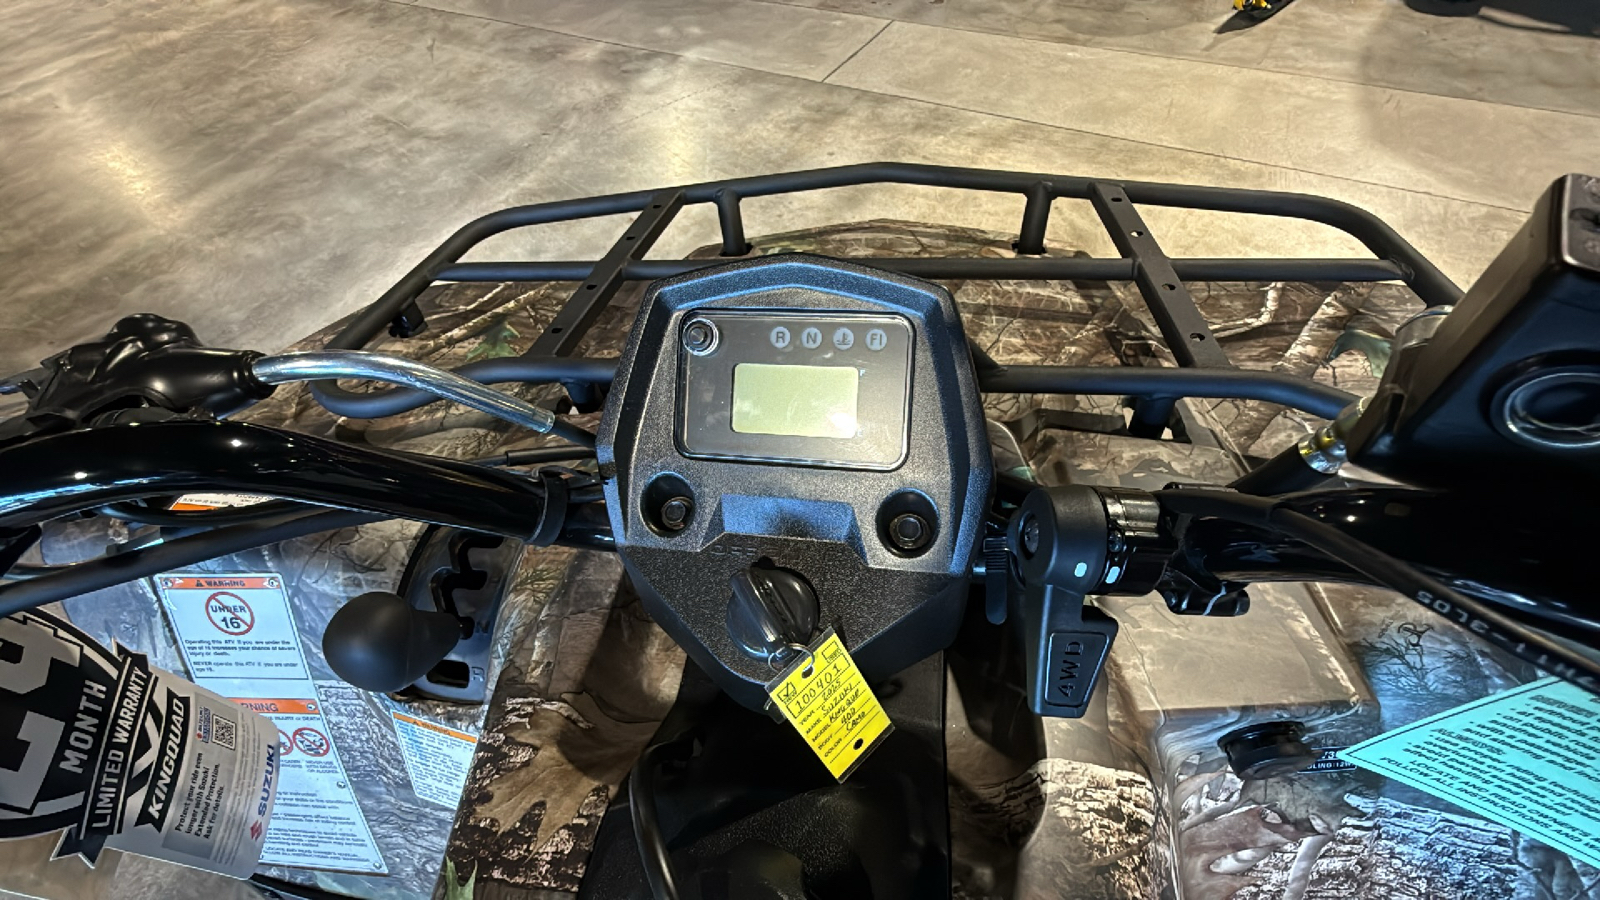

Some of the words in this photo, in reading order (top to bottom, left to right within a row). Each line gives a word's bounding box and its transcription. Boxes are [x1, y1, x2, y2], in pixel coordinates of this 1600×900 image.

[775, 331, 786, 344] R
[806, 332, 817, 344] N
[870, 333, 883, 345] FI
[210, 605, 247, 613] UNDER
[221, 617, 241, 629] 16
[1058, 641, 1084, 697] 4WD
[795, 663, 842, 714] 100401
[59, 679, 107, 774] MONTH
[799, 710, 815, 725] YEAR
[806, 718, 822, 734] MAKE
[92, 750, 124, 828] LIMITED
[112, 666, 148, 744] WARRANTY
[148, 698, 185, 820] KINGQUAD
[195, 752, 203, 769] even
[824, 738, 842, 757] COLOR
[191, 769, 199, 786] ride
[1458, 747, 1507, 763] proper
[1506, 765, 1548, 782] riding
[187, 785, 196, 803] your
[258, 744, 275, 818] SUZUKI
[1409, 760, 1460, 781] LOCATE
[1458, 781, 1489, 792] AND
[1489, 793, 1527, 808] READ
[185, 808, 196, 834] longer
[194, 793, 202, 809] with
[200, 766, 210, 791] Suzuki
[1380, 757, 1432, 777] FOLLOW
[1430, 778, 1453, 788] ALL
[1455, 788, 1552, 828] INSTRUCTIONS
[1551, 830, 1582, 842] AND
[175, 802, 191, 832] Protect
[194, 801, 211, 837] Extended
[203, 822, 213, 839] Ask
